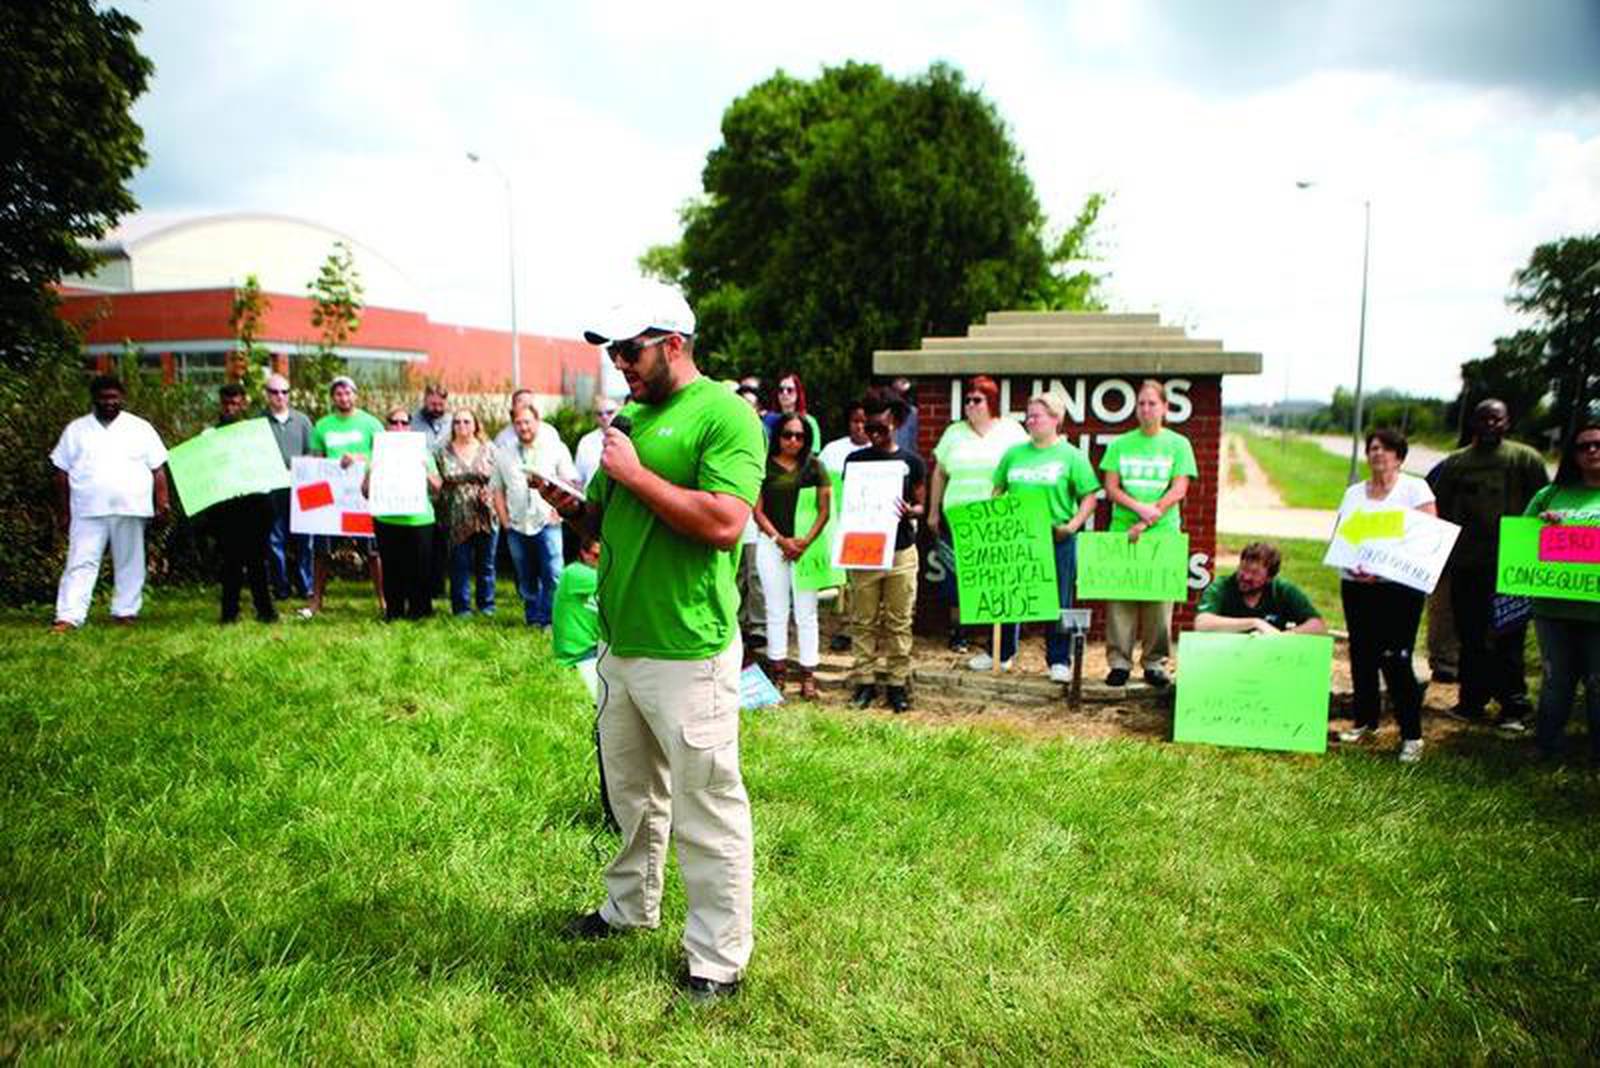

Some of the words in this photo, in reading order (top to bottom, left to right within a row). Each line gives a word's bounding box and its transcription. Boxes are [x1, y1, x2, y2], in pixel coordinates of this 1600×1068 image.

[951, 379, 1193, 423] ILNOS
[965, 496, 1021, 520] STOP
[974, 518, 1039, 543] VERBAL
[976, 544, 1040, 566] MENTAL
[978, 563, 1054, 587] PHYSICAL
[1503, 563, 1600, 593] CONSEQUE
[976, 583, 1041, 620] ABUSE
